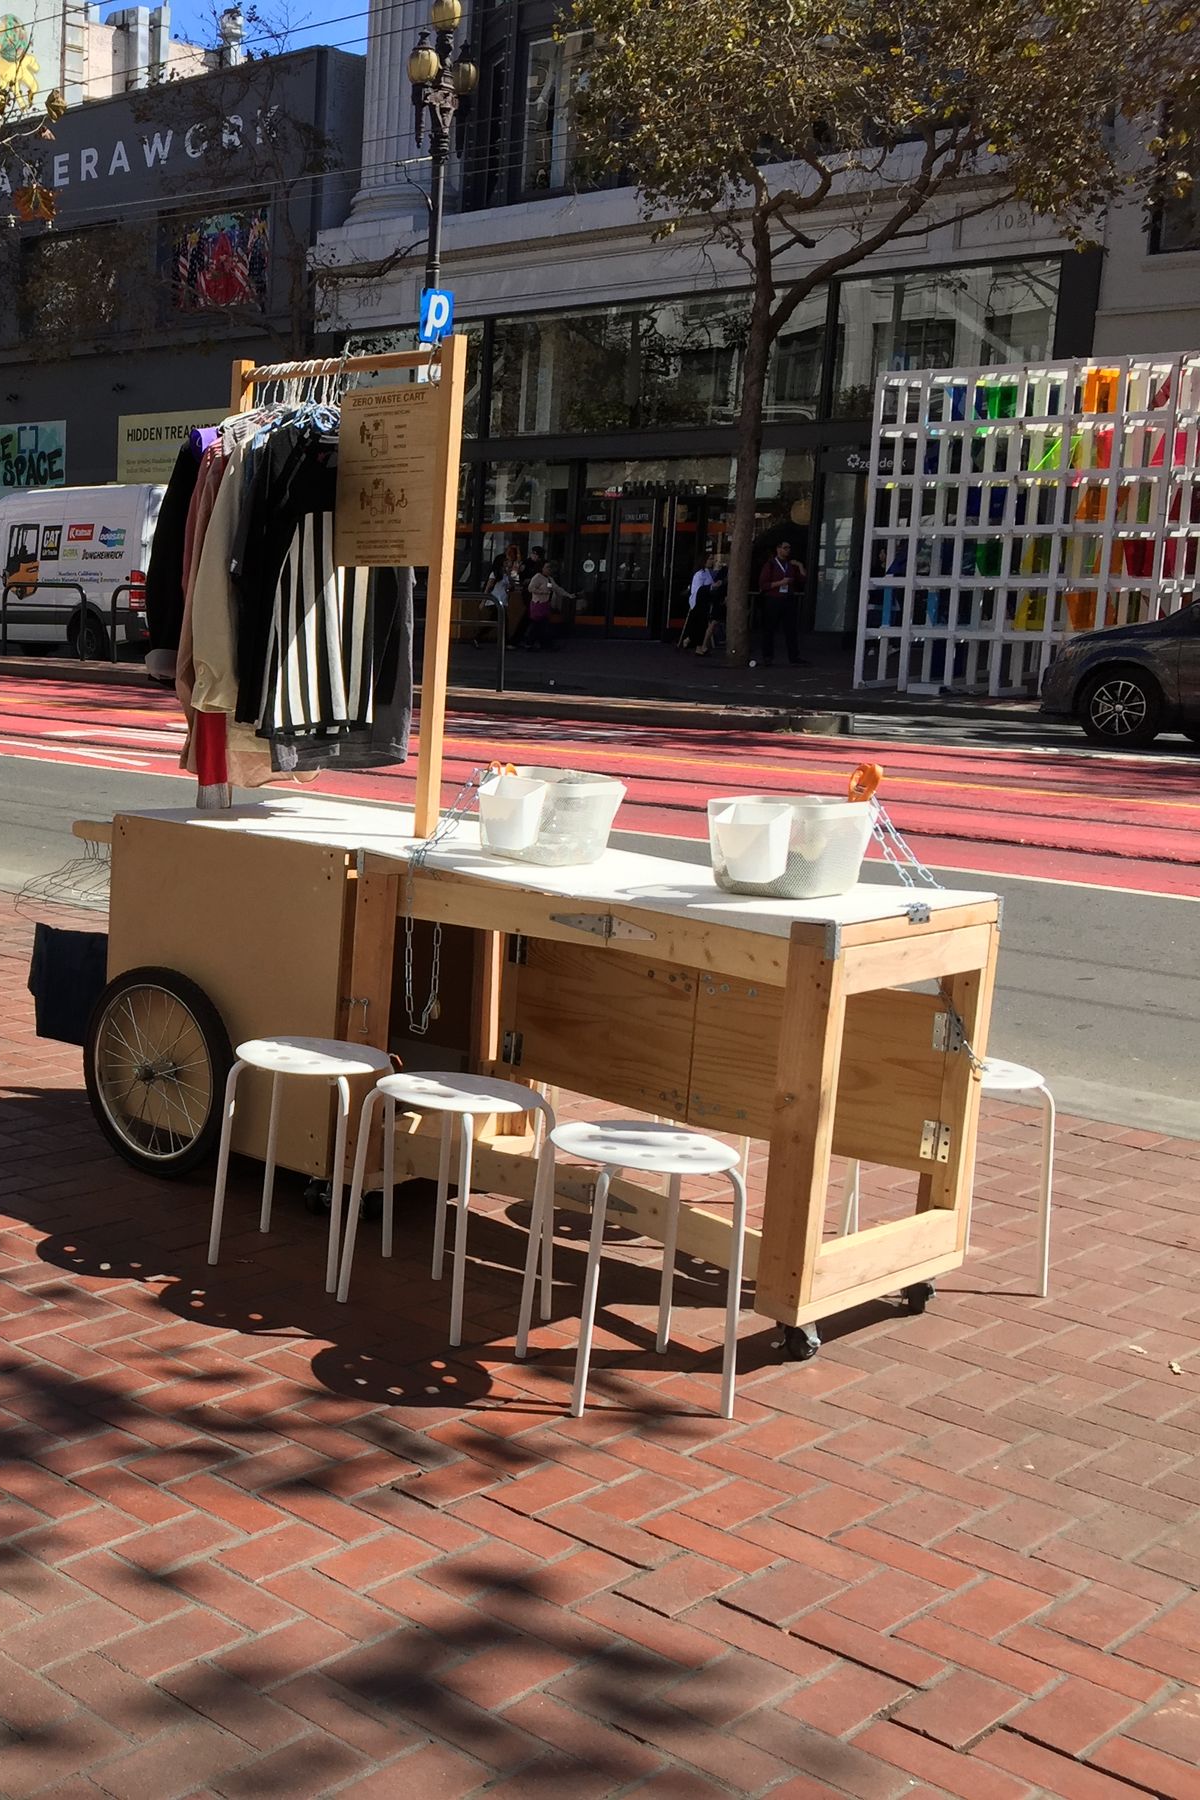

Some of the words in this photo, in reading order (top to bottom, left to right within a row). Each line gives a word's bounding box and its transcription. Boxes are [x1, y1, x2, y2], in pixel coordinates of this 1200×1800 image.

[352, 396, 374, 408] ZERO
[375, 393, 401, 405] WASTE
[403, 391, 426, 402] CART
[126, 426, 163, 442] HIDDEN
[164, 423, 218, 440] TREA
[2, 447, 64, 487] SPACE
[860, 457, 906, 469] zedek
[43, 530, 60, 548] CAT
